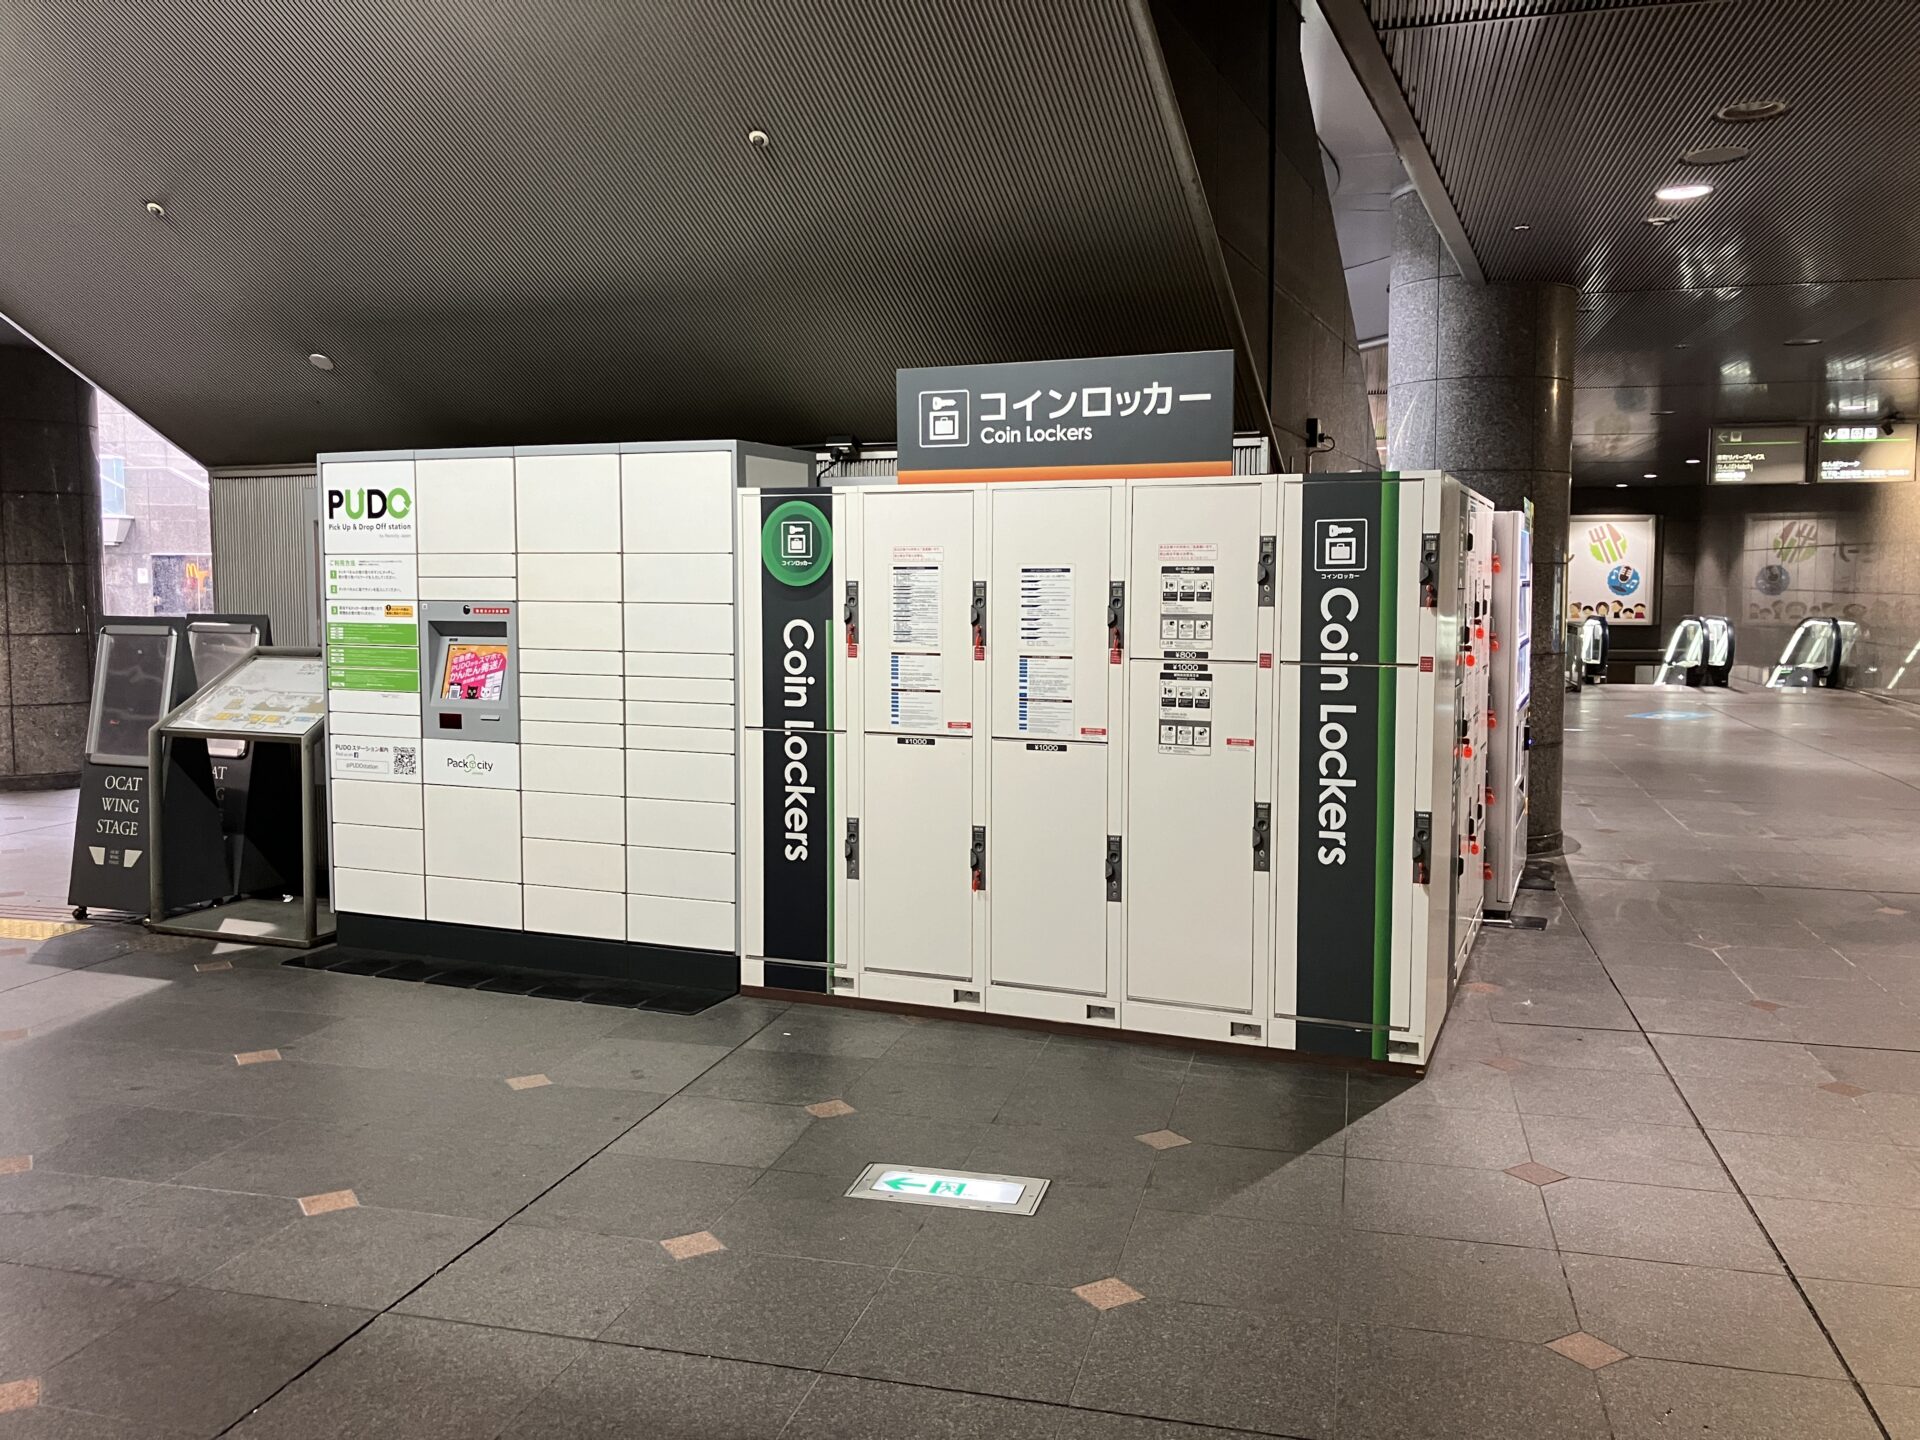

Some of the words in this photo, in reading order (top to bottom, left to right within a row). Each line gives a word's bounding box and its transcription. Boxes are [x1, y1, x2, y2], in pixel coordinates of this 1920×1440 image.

[980, 381, 1212, 422] コインロッカー
[980, 425, 1021, 445] Coin
[1025, 424, 1093, 442] Lockers
[328, 488, 412, 520] PUDO
[342, 524, 351, 532] Up
[358, 524, 374, 532] Drop
[1319, 587, 1359, 691] Coin
[783, 618, 816, 707] Coin
[104, 775, 143, 791] OCAT
[211, 766, 228, 780] AT
[1317, 704, 1357, 867] Lockers
[783, 720, 816, 862] Lockers
[102, 797, 140, 813] WING
[96, 819, 139, 836] STAGE
